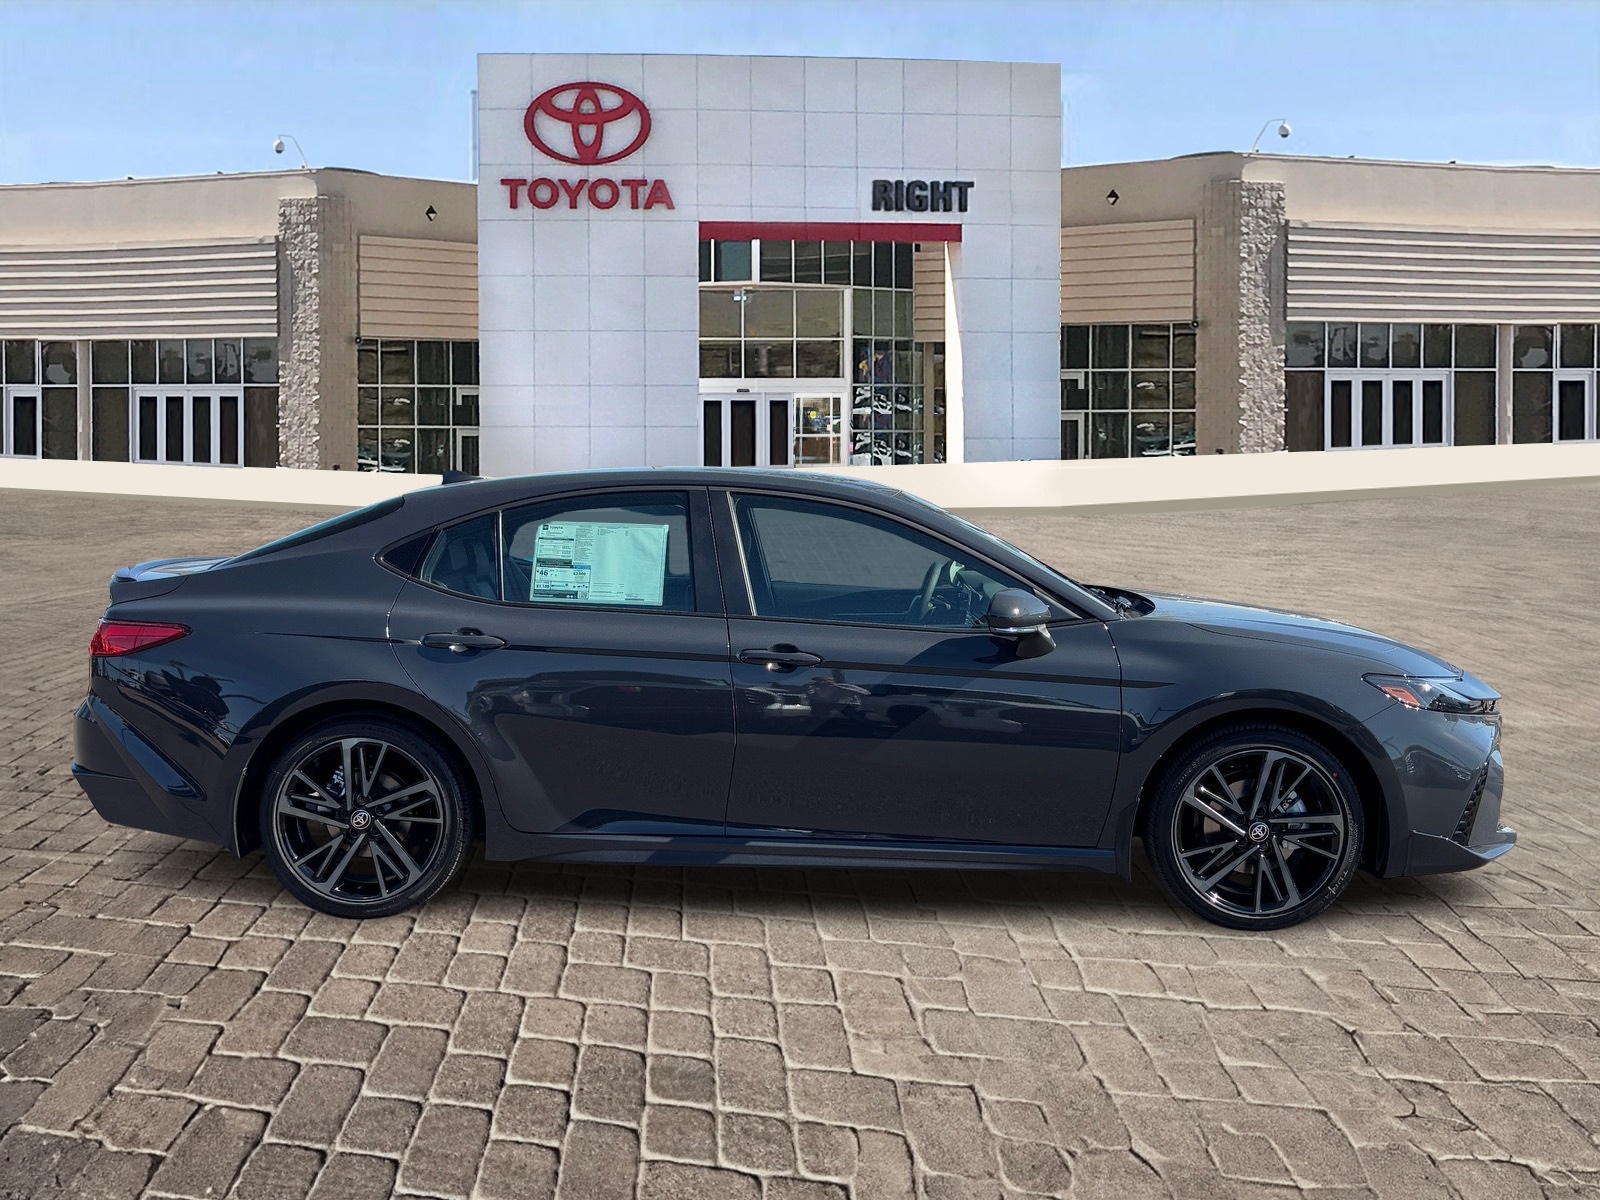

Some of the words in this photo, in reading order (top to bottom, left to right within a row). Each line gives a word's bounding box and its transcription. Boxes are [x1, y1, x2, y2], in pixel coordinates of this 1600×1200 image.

[500, 177, 675, 210] TOYOTA
[872, 179, 974, 212] RIGHT
[539, 569, 549, 577] 46
